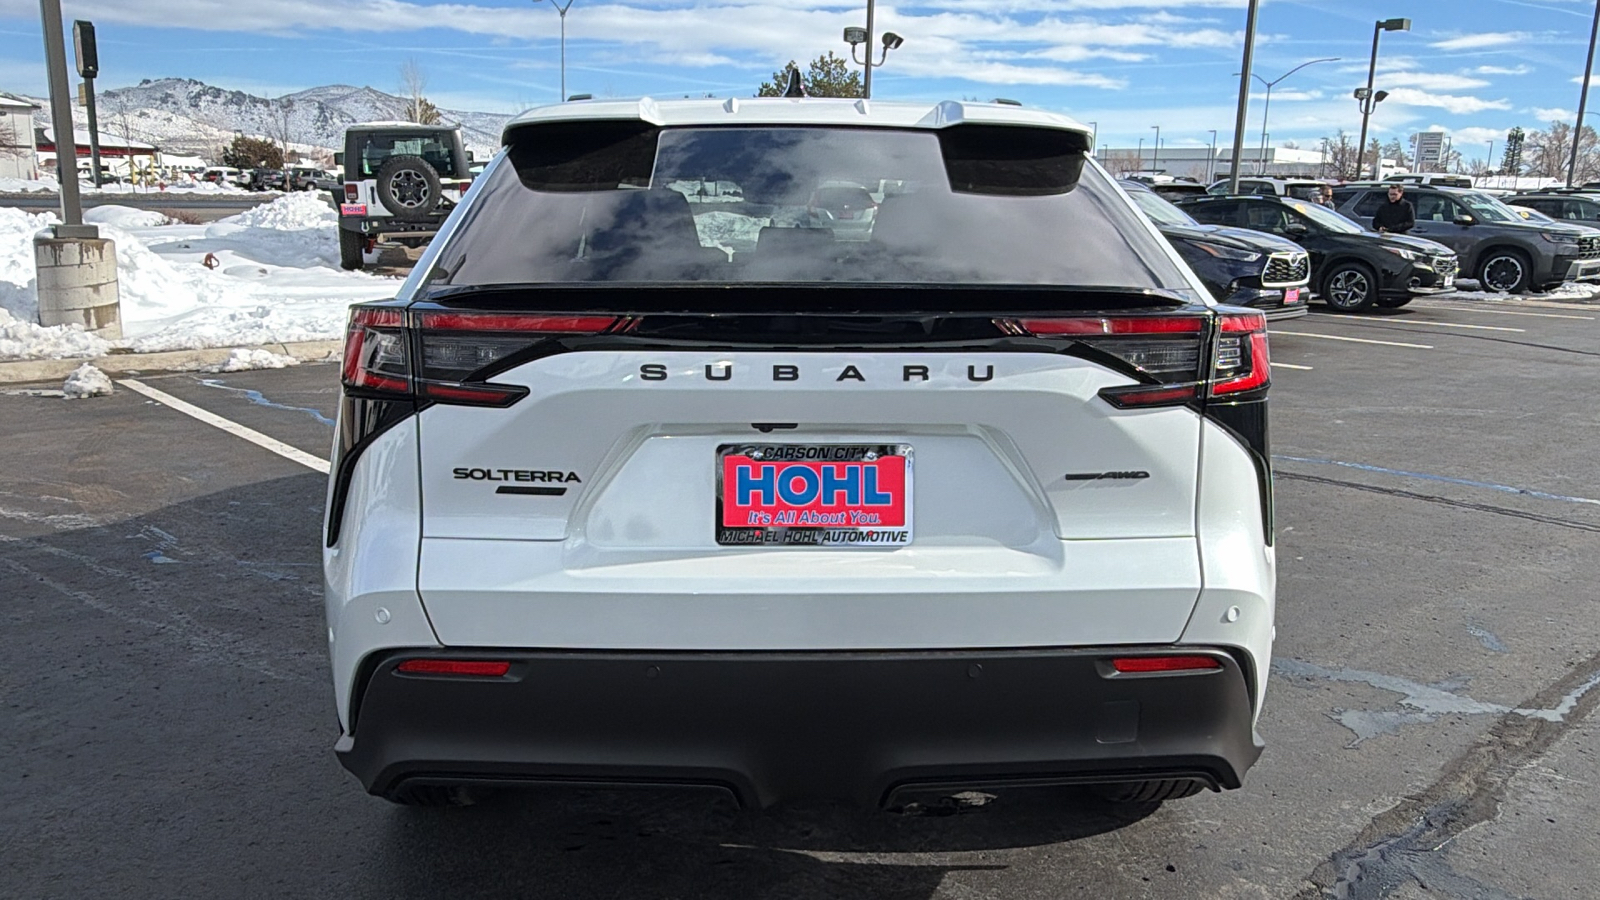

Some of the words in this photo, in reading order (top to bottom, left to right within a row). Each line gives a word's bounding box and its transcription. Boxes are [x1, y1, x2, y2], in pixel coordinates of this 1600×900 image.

[640, 363, 994, 382] SUBARU
[763, 447, 833, 459] CARSON
[835, 447, 869, 459] CITY
[453, 467, 582, 483] SOLTERRA
[1097, 471, 1150, 480] AWD
[736, 465, 892, 506] HOHL
[748, 510, 771, 524] It's
[775, 510, 795, 524] All
[799, 510, 845, 524] About
[850, 510, 881, 524] You.
[720, 530, 779, 543] MICHAEL
[783, 530, 818, 543] HOHL
[822, 530, 908, 542] AUTOMOTIVE
